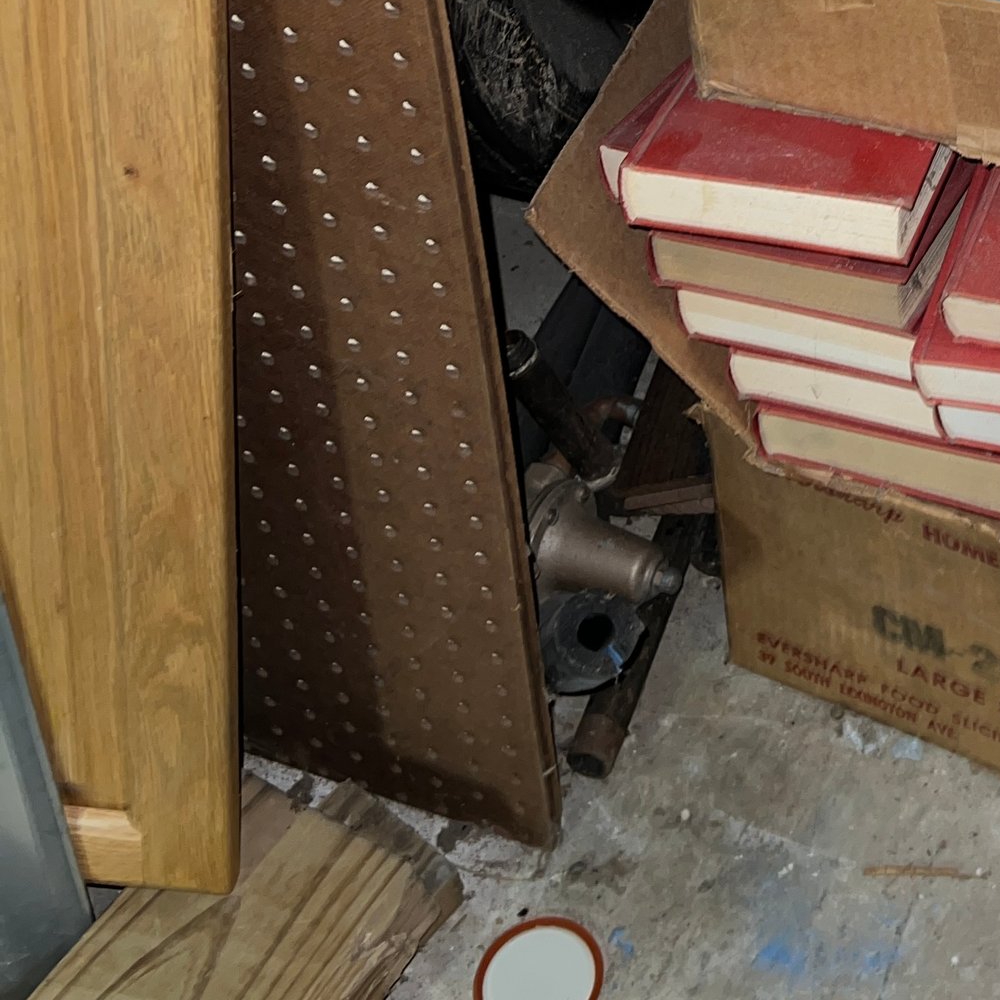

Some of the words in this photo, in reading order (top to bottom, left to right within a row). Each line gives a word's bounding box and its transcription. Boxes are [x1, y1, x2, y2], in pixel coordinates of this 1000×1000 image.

[922, 524, 1000, 569] HOME
[756, 632, 867, 684] EVERSHARP
[881, 683, 939, 715] FOOD
[784, 660, 831, 689] SOUTH
[839, 683, 917, 723] LEXINGTON
[897, 658, 985, 705] LARGE
